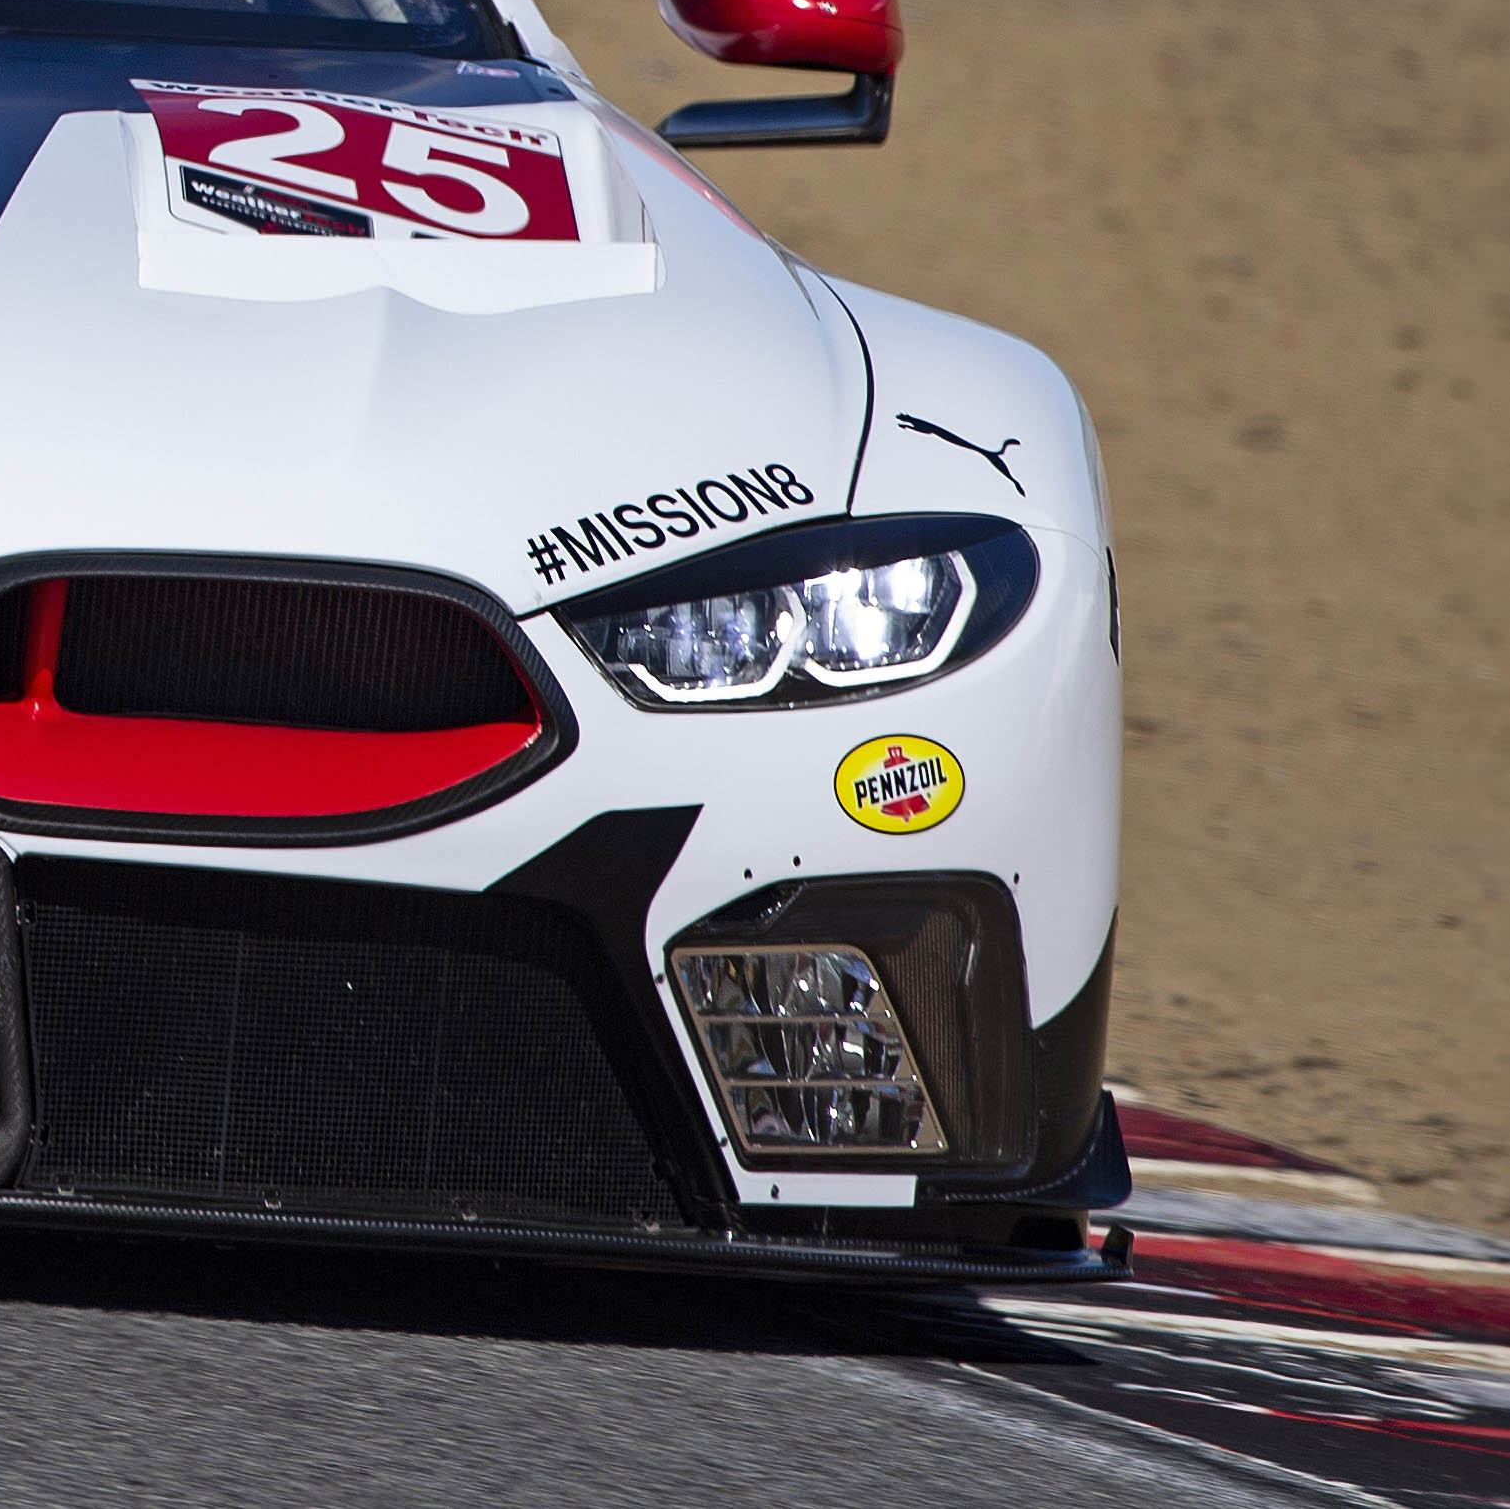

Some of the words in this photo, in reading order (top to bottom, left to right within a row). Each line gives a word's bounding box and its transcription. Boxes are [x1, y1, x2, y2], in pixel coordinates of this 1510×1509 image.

[197, 97, 530, 236] 25
[527, 462, 816, 585] #MISSION8
[853, 756, 948, 810] PENNZOIL
